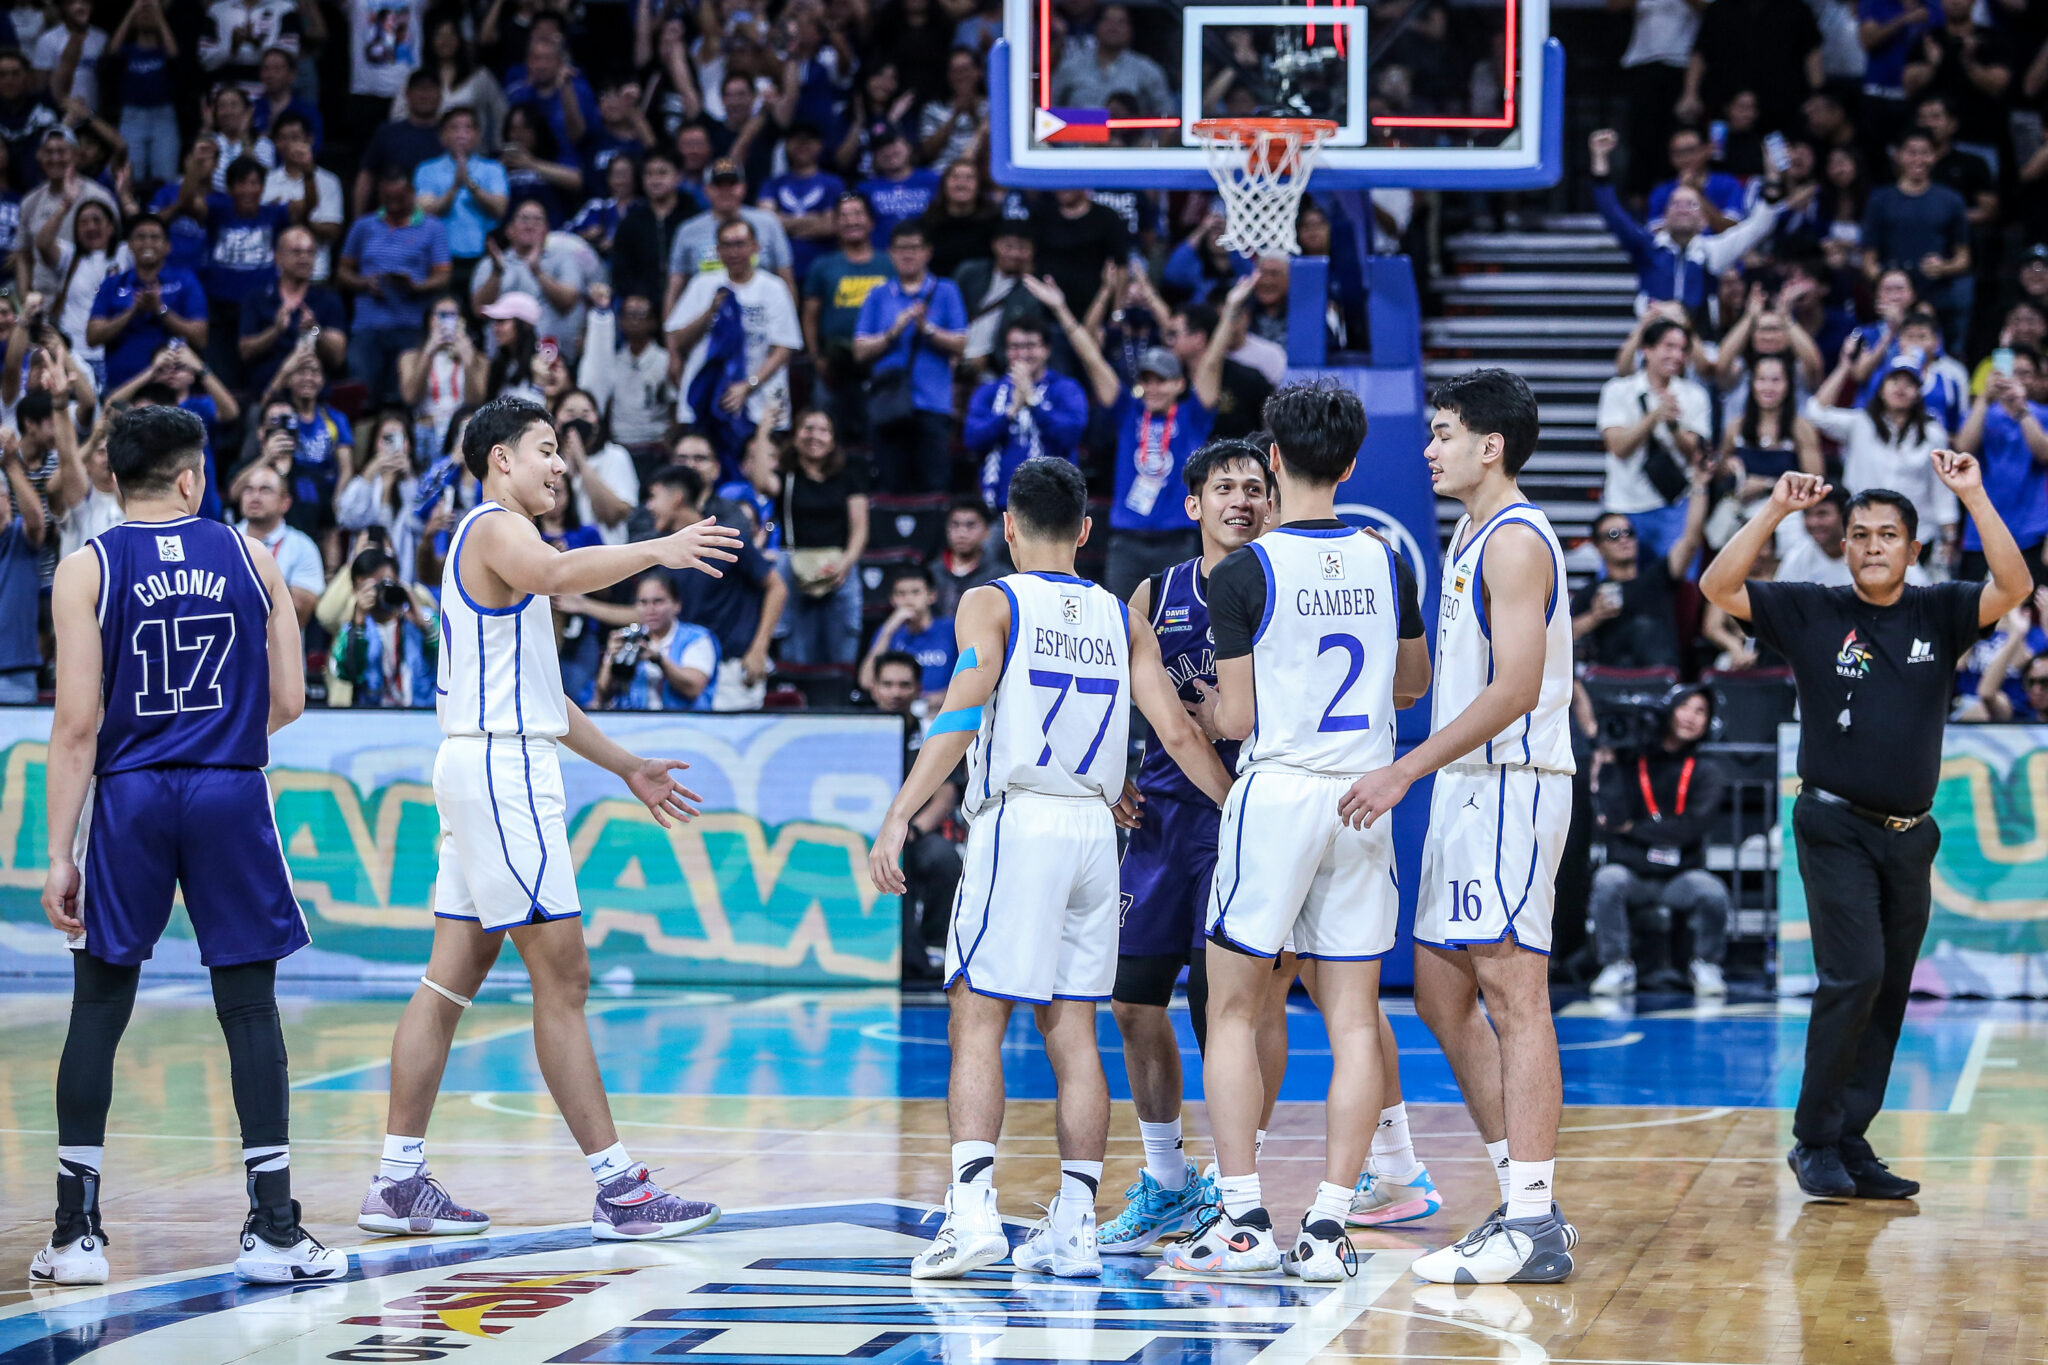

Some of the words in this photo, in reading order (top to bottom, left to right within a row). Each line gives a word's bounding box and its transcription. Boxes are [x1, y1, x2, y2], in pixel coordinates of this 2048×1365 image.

[133, 569, 226, 607] COLONIA
[1297, 588, 1377, 616] GAMBER
[1165, 608, 1189, 617] DAVIES
[133, 613, 236, 716] 17
[1034, 627, 1117, 666] ESPINOSA
[1317, 633, 1370, 733] 2
[1029, 669, 1120, 776] 77
[1448, 879, 1482, 922] 16
[336, 1269, 641, 1334] ASIA
[326, 1334, 472, 1363] OF
